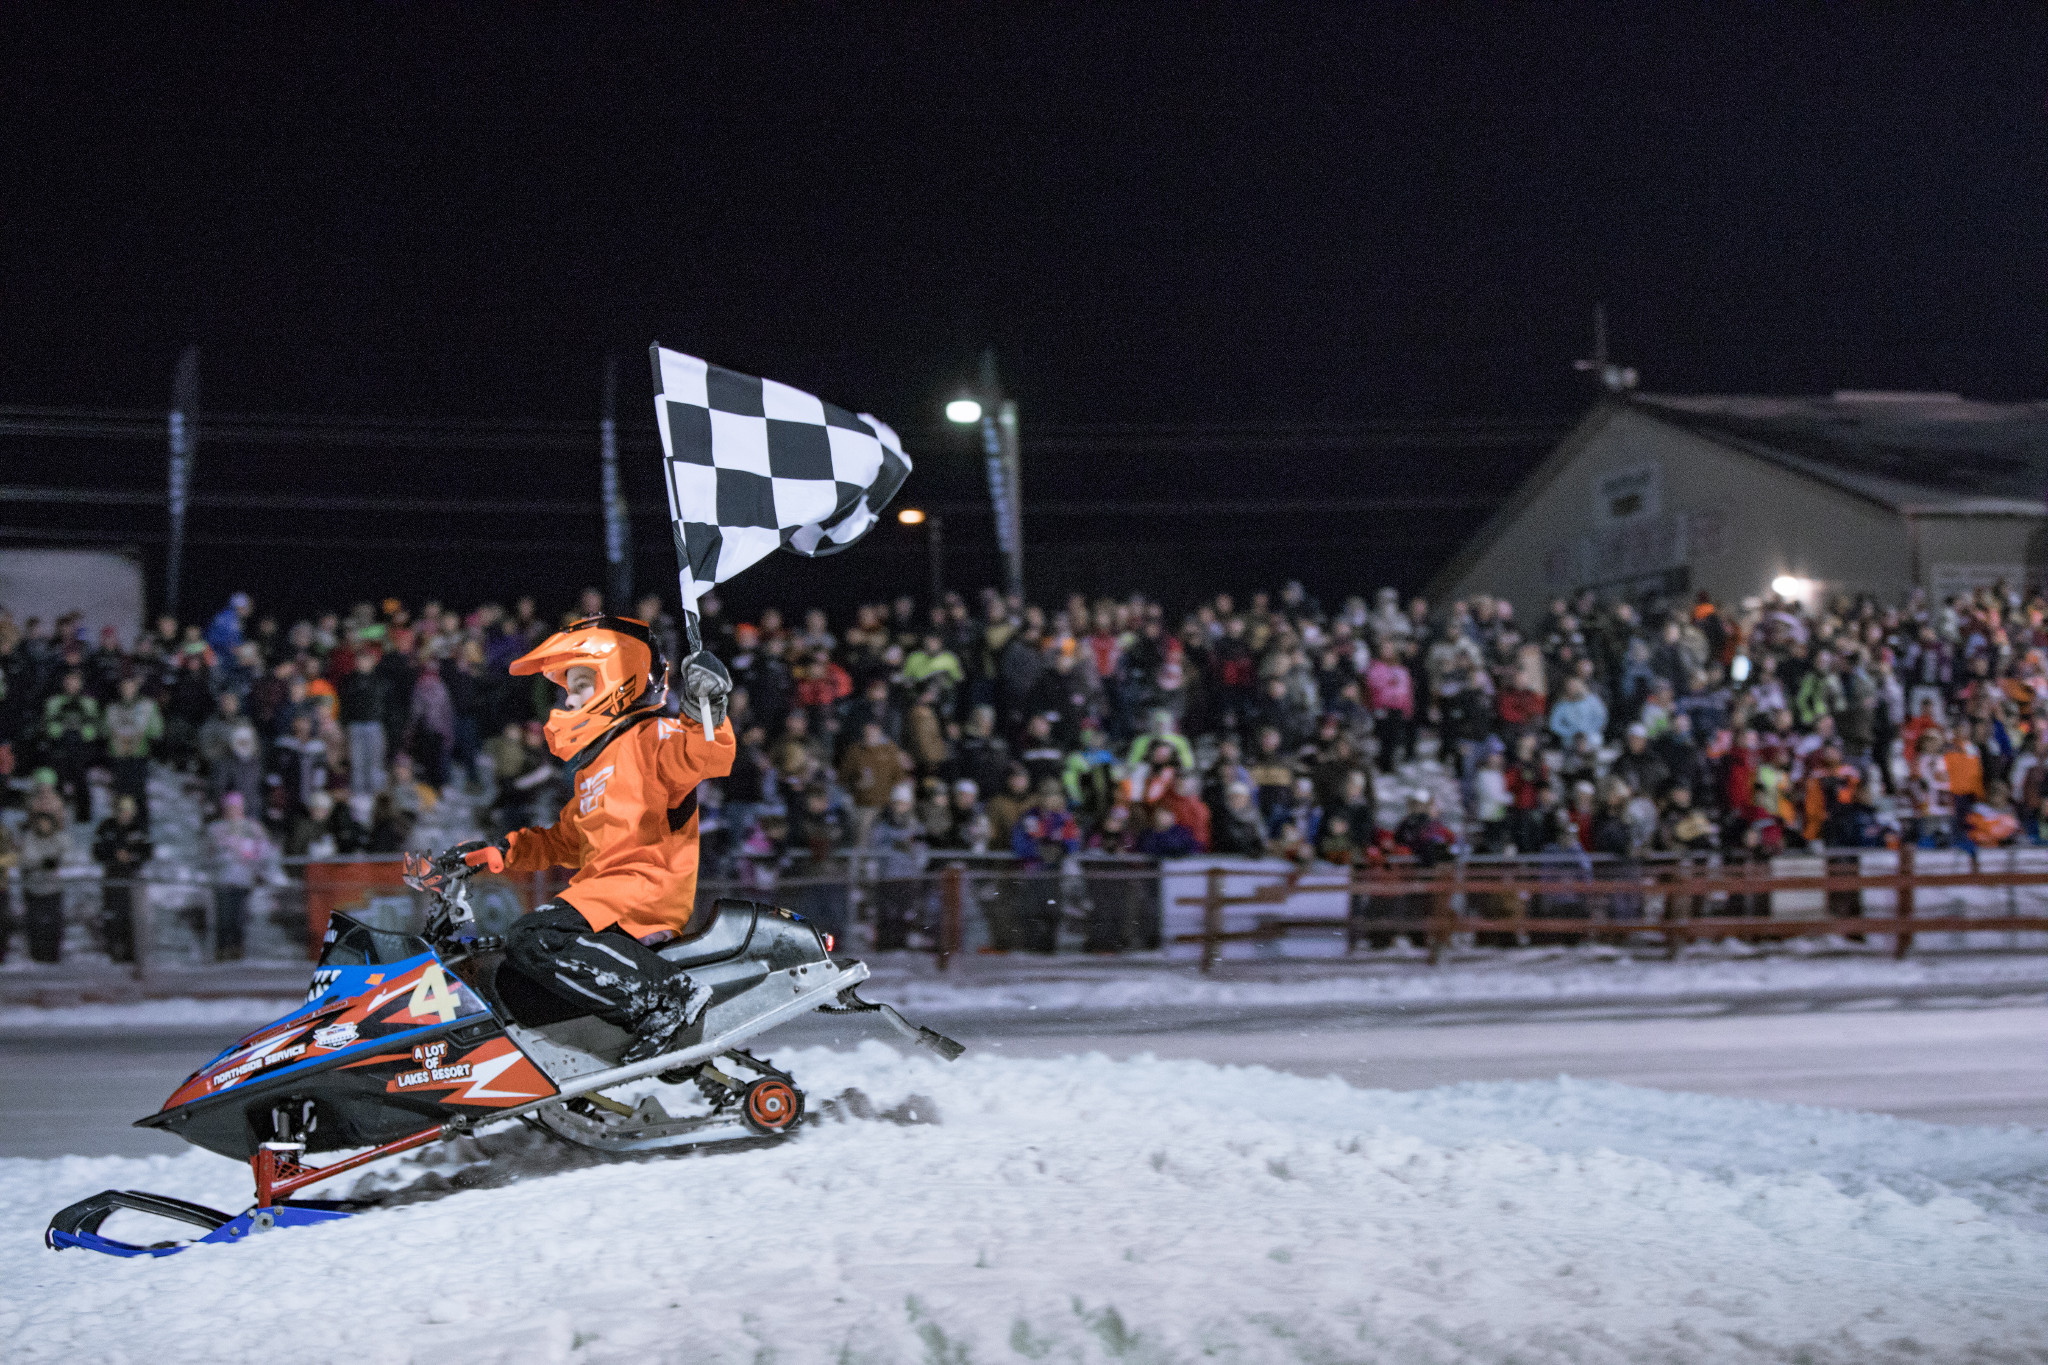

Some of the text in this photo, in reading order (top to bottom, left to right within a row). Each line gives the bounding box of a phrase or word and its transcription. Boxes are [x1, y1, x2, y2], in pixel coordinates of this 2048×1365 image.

[408, 963, 461, 1023] 4
[414, 1043, 445, 1060] A LOT
[425, 1057, 439, 1069] OF
[213, 1058, 263, 1085] NORTHSIDE
[265, 1044, 306, 1065] SERVICE
[397, 1063, 471, 1087] LAKES RESORT
